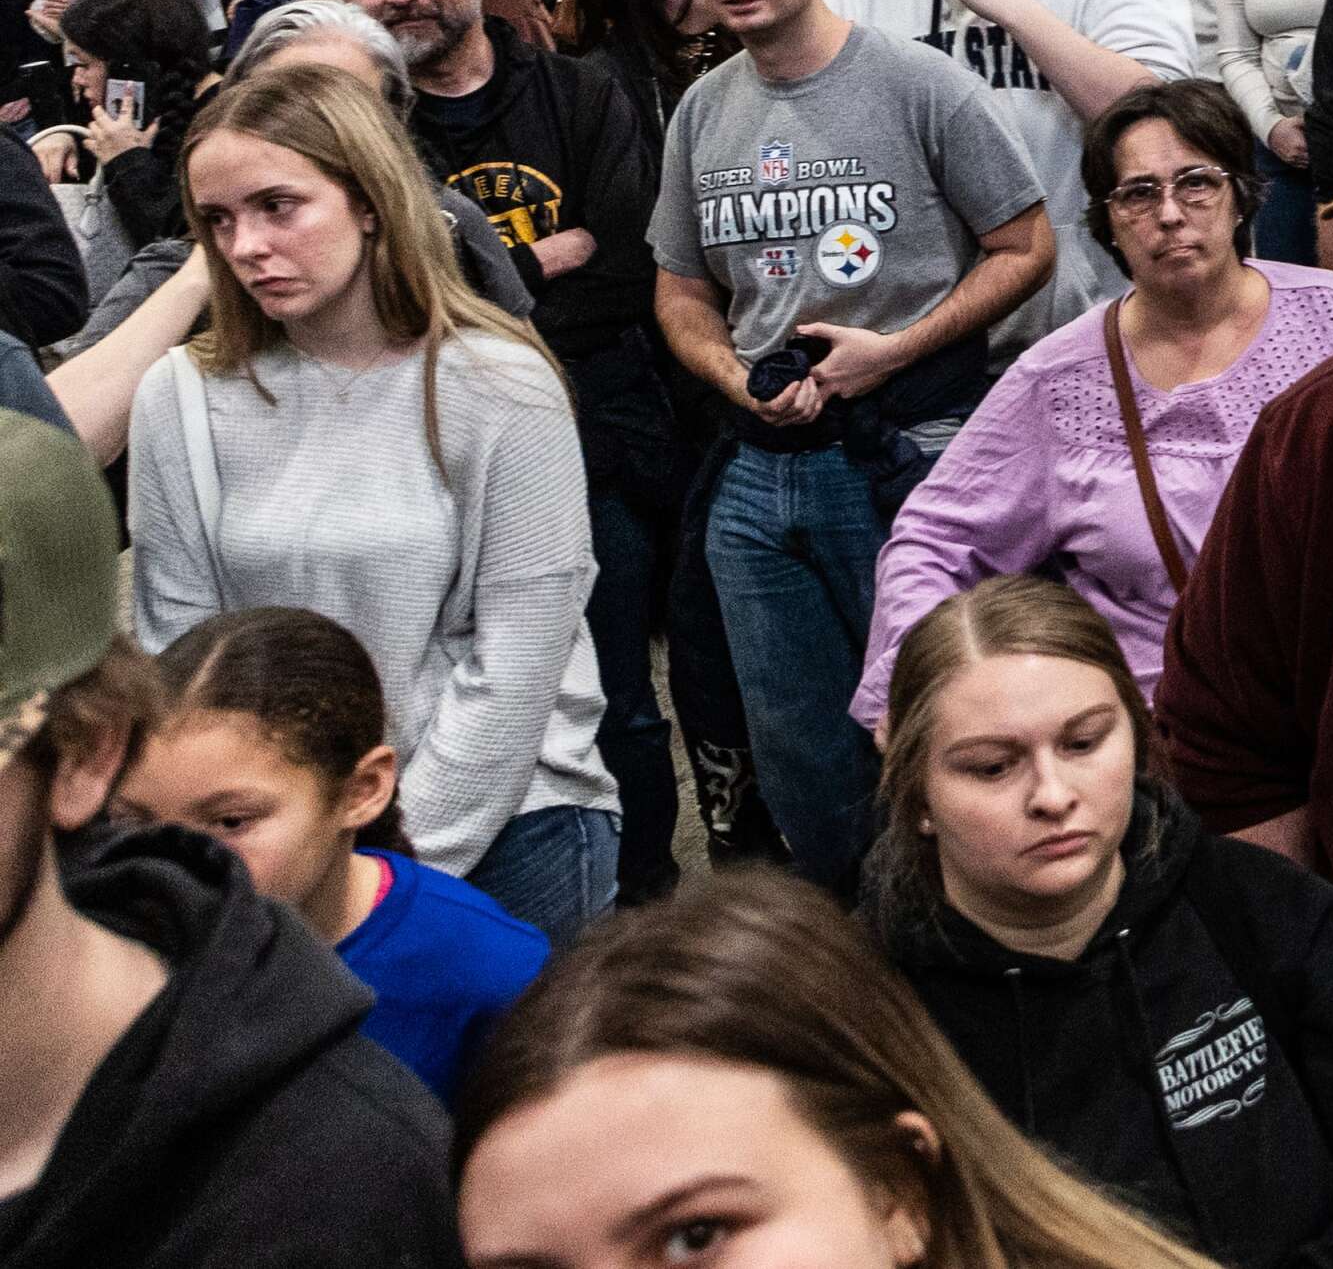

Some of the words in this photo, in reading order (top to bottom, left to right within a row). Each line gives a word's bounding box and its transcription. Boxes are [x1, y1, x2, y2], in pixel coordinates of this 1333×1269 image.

[965, 26, 1052, 90] STA
[700, 168, 752, 191] SUPER
[796, 158, 864, 179] BOWL
[762, 161, 788, 178] NFL
[701, 183, 897, 247] HAMPIONS
[1158, 1016, 1266, 1092] BATTLEFIE
[1164, 1043, 1268, 1112] MOTORCYC
